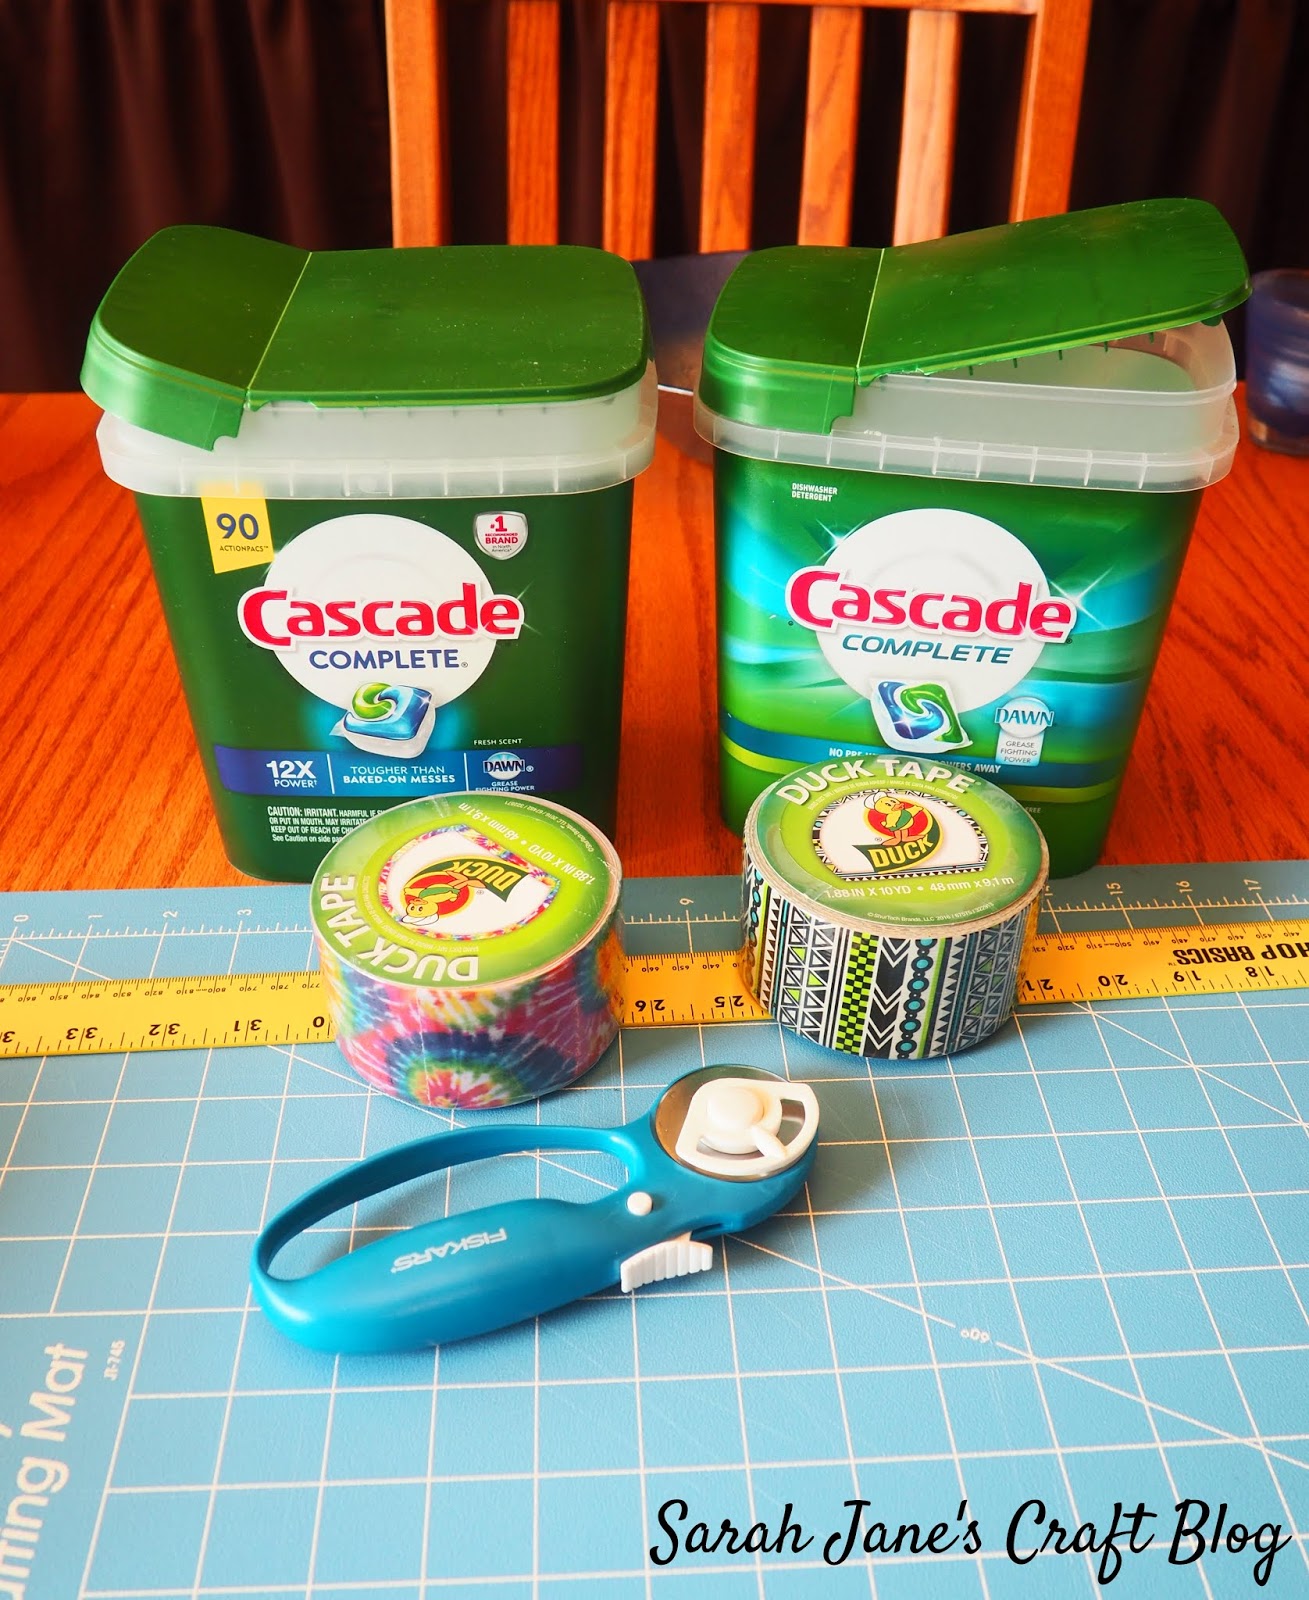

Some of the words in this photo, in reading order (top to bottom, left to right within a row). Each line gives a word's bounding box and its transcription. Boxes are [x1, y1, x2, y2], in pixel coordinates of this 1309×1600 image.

[792, 483, 838, 495] DISHWASHER
[792, 491, 832, 502] DETERGENT
[216, 513, 259, 540] 90
[789, 569, 1072, 639] Cascade
[242, 582, 521, 647] Cascade
[842, 634, 1014, 665] COMPLETE
[308, 649, 459, 669] COMPLETE
[996, 708, 1053, 726] DAWN
[829, 748, 844, 757] NO
[266, 760, 316, 779] 12X
[350, 766, 408, 775] TOUGHER
[411, 765, 445, 774] THAN
[483, 760, 525, 773] DAWN
[974, 764, 1001, 774] AWAY
[343, 775, 407, 784] BAKED-ON
[410, 774, 455, 784] MESSES
[775, 760, 874, 806] DUCK
[876, 759, 977, 793] TAPE
[339, 809, 369, 817] HARMFUL
[279, 817, 291, 825] PUT
[271, 825, 286, 833] KEEP
[300, 826, 309, 834] OF
[310, 826, 331, 834] REACH
[272, 834, 284, 842] See
[284, 834, 308, 842] Caution
[867, 835, 934, 868] DUCK
[452, 861, 522, 892] DUCK
[1106, 882, 1124, 896] 15
[1176, 880, 1193, 893] 16
[1243, 878, 1262, 891] 17
[162, 910, 178, 918] 2
[320, 875, 371, 949] TAPE
[356, 936, 479, 982] DUCK
[392, 1228, 508, 1273] FISKARS
[20, 1342, 89, 1442] Mat
